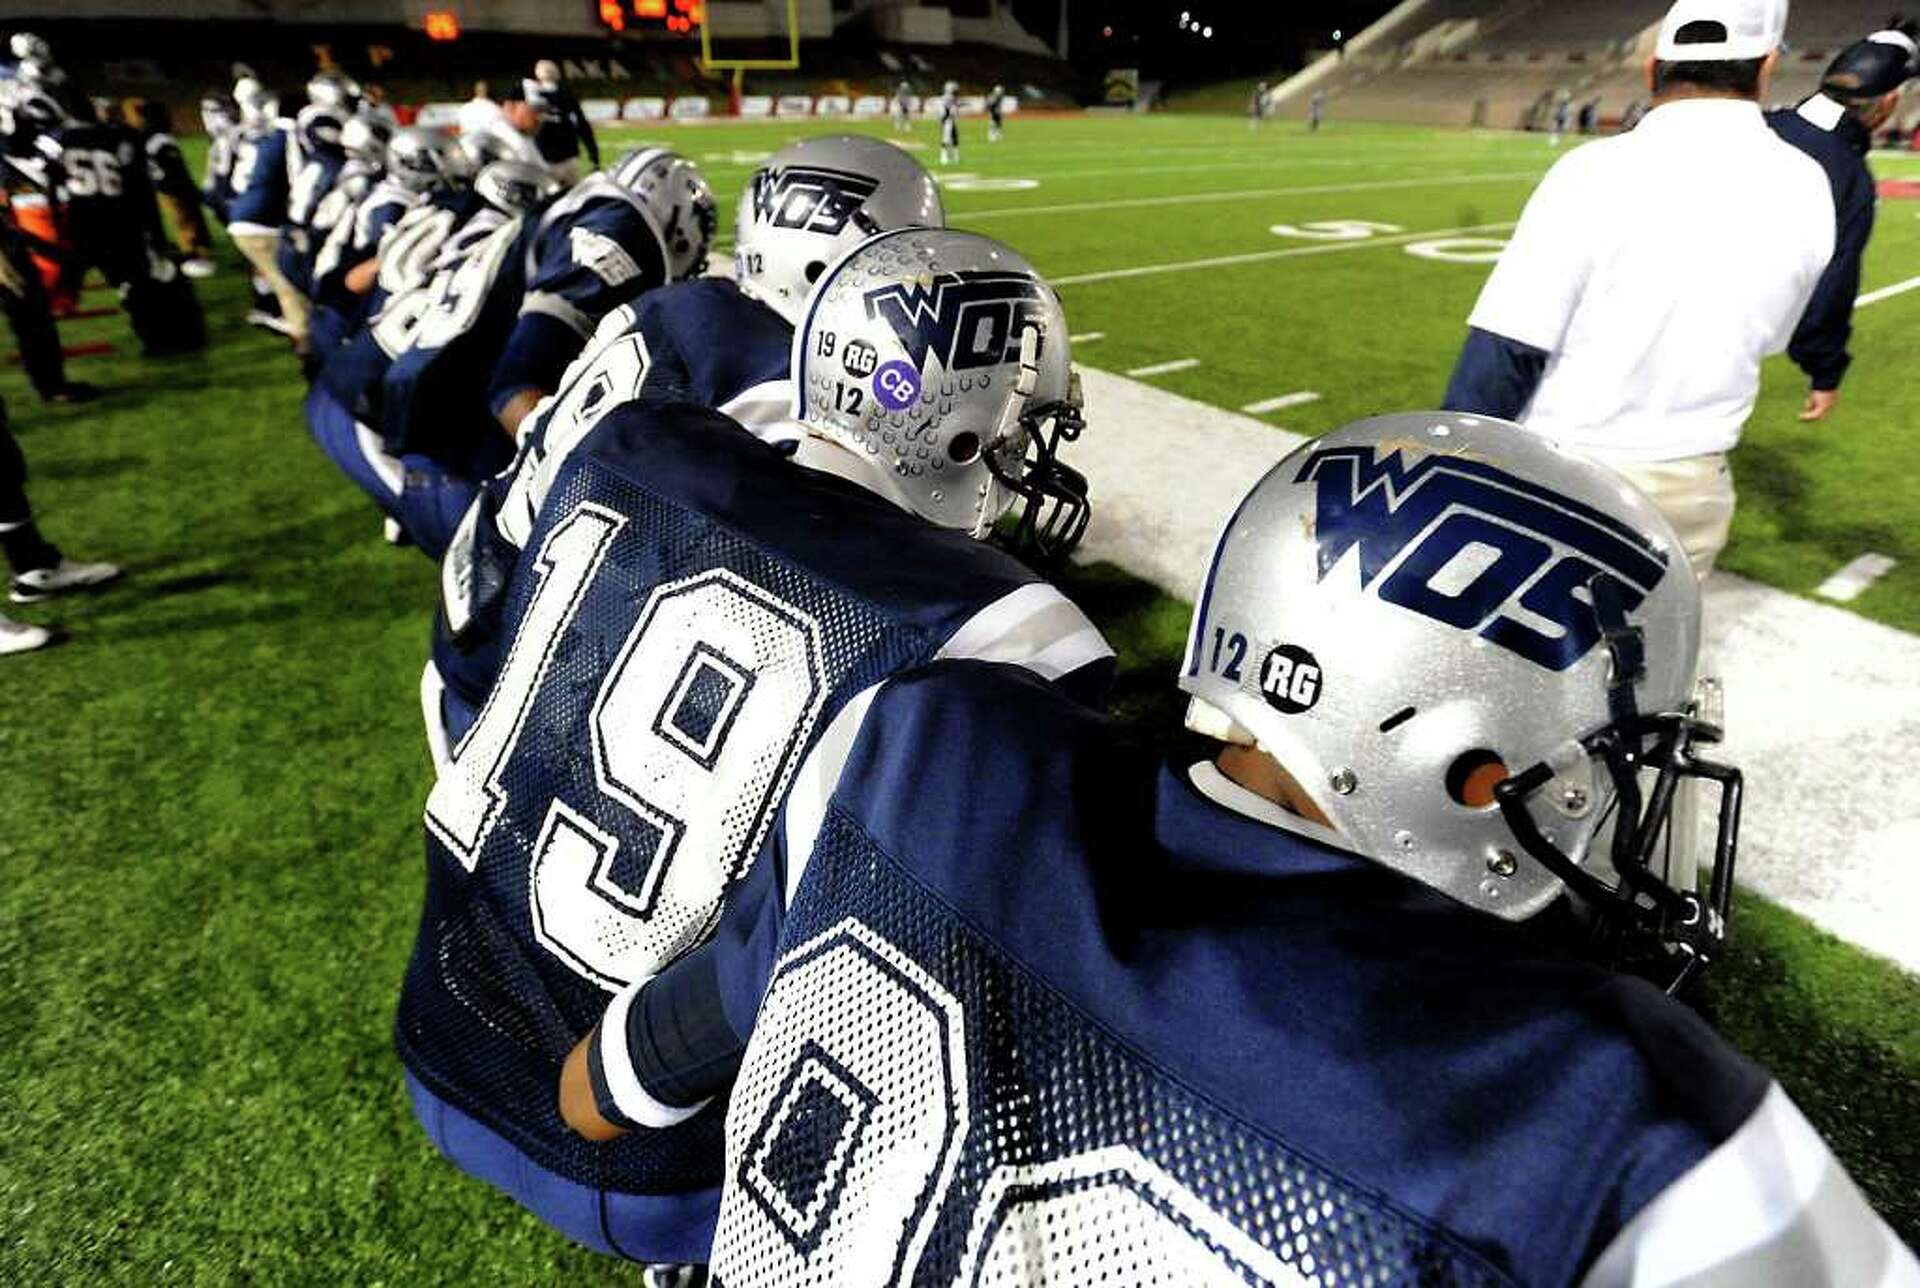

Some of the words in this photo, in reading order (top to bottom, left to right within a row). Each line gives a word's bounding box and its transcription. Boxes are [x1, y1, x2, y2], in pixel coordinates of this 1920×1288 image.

[752, 166, 880, 236] WOS
[817, 330, 836, 357] 19
[845, 344, 876, 373] RG
[836, 381, 864, 417] 12
[881, 369, 915, 403] CB
[1294, 444, 1670, 673] WOS
[1211, 627, 1248, 684] 12
[1263, 652, 1320, 706] RG
[424, 500, 829, 1000] 19
